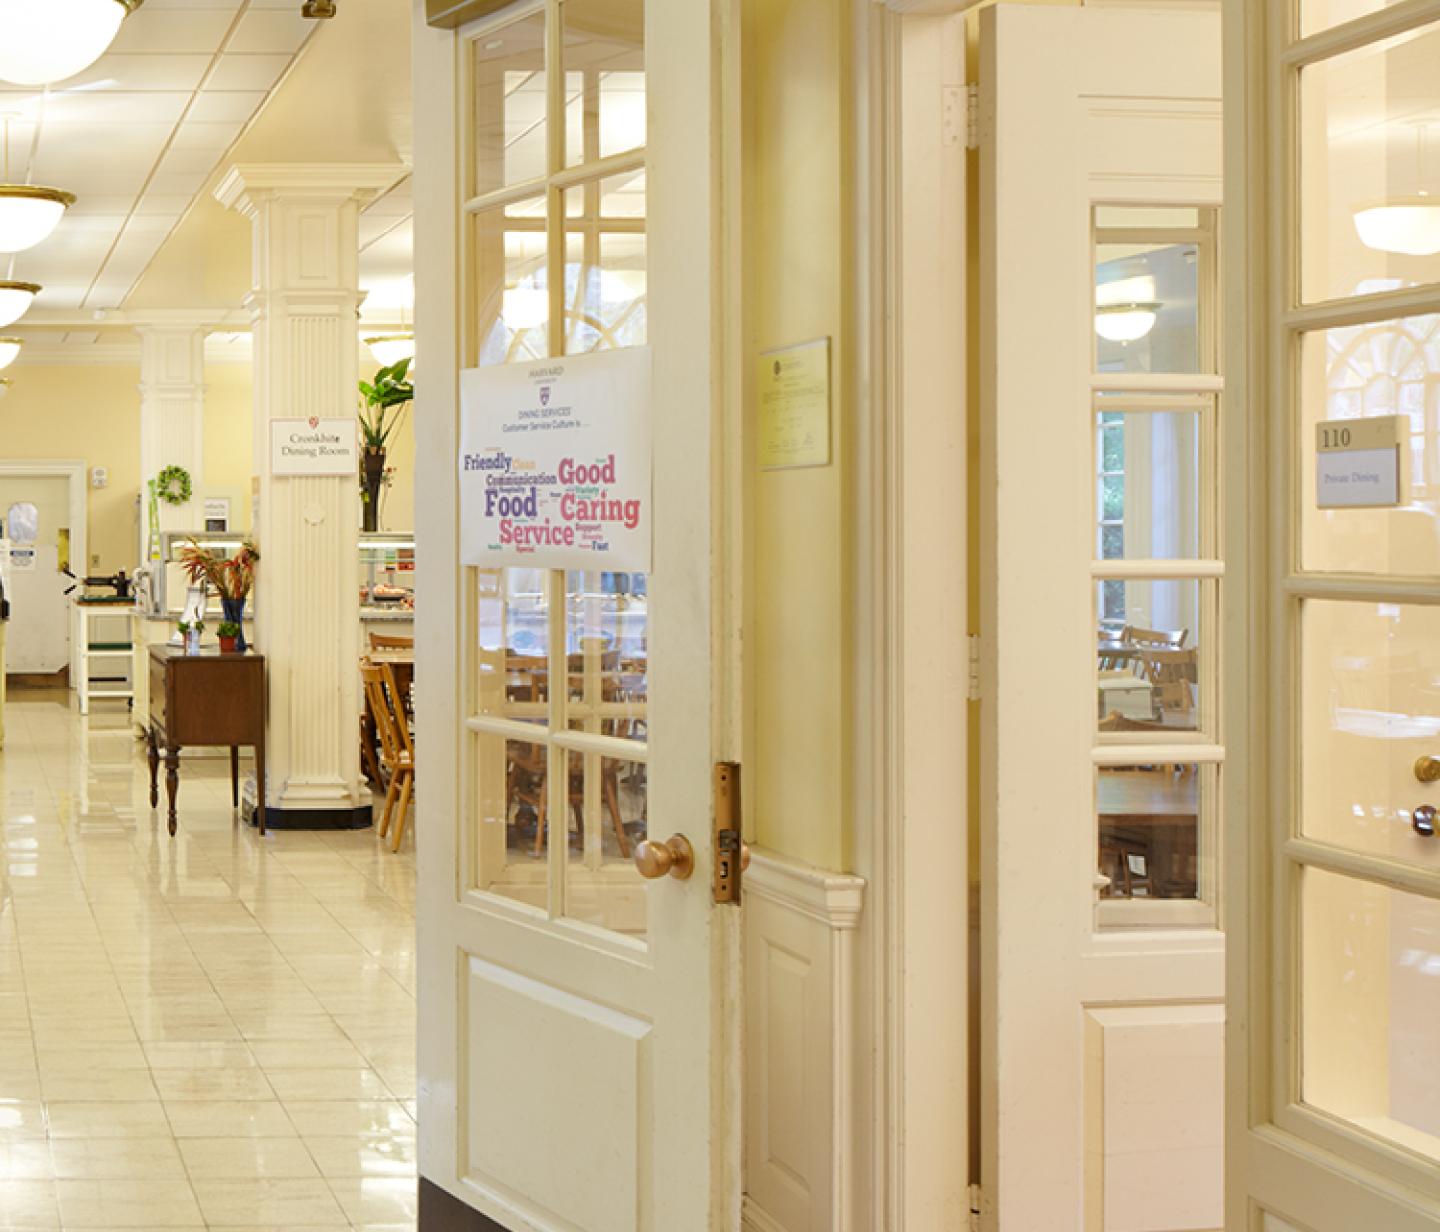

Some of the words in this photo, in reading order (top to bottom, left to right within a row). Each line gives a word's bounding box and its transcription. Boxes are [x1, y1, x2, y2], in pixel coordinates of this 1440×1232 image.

[529, 366, 564, 378] HARVARD
[518, 410, 540, 419] DINING
[1323, 428, 1350, 448] 110
[281, 446, 317, 458] Dining
[319, 446, 350, 456] Room
[464, 453, 512, 473] Friendly
[558, 454, 616, 484] Good
[486, 473, 557, 486] Communication
[1324, 474, 1349, 484] Private
[1351, 472, 1379, 485] Dining
[485, 487, 537, 516] Food
[560, 490, 641, 528] Caring
[499, 517, 574, 545] Service
